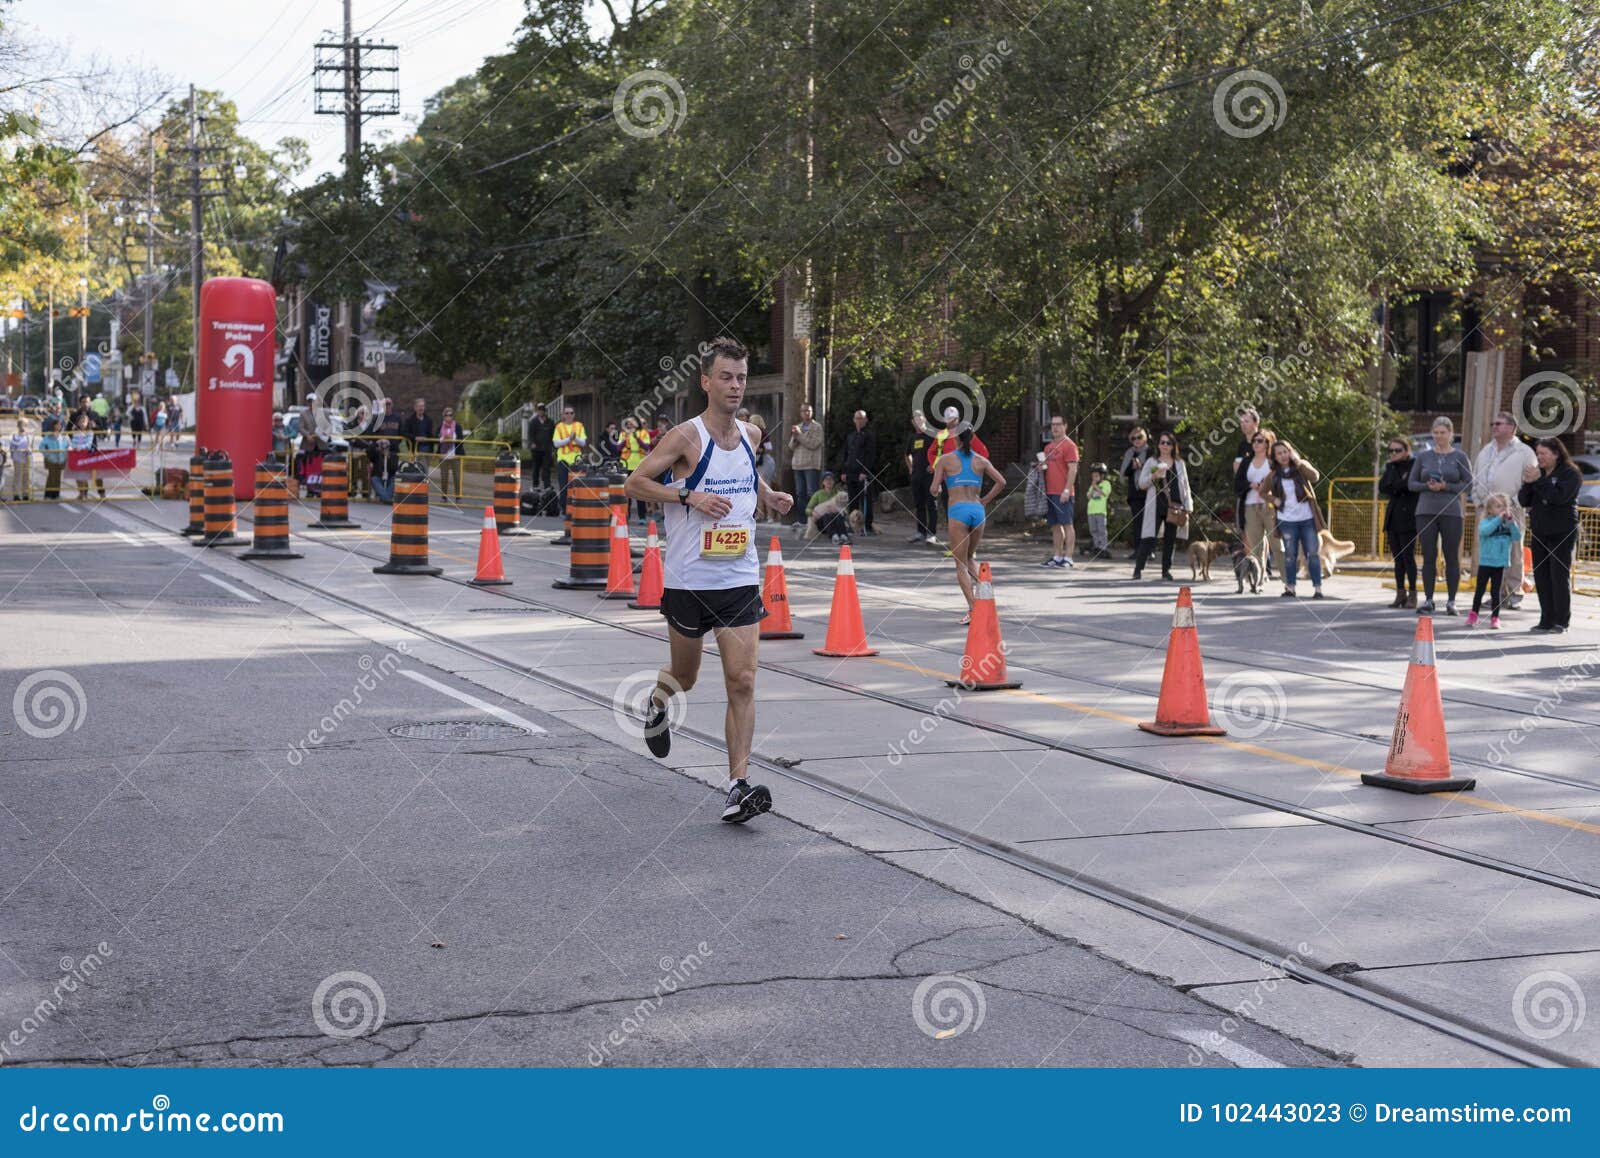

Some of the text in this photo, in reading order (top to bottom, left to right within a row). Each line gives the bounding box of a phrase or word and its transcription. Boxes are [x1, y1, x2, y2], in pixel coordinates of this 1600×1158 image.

[225, 331, 252, 341] Point
[366, 351, 383, 362] 40
[716, 532, 747, 544] 4225
